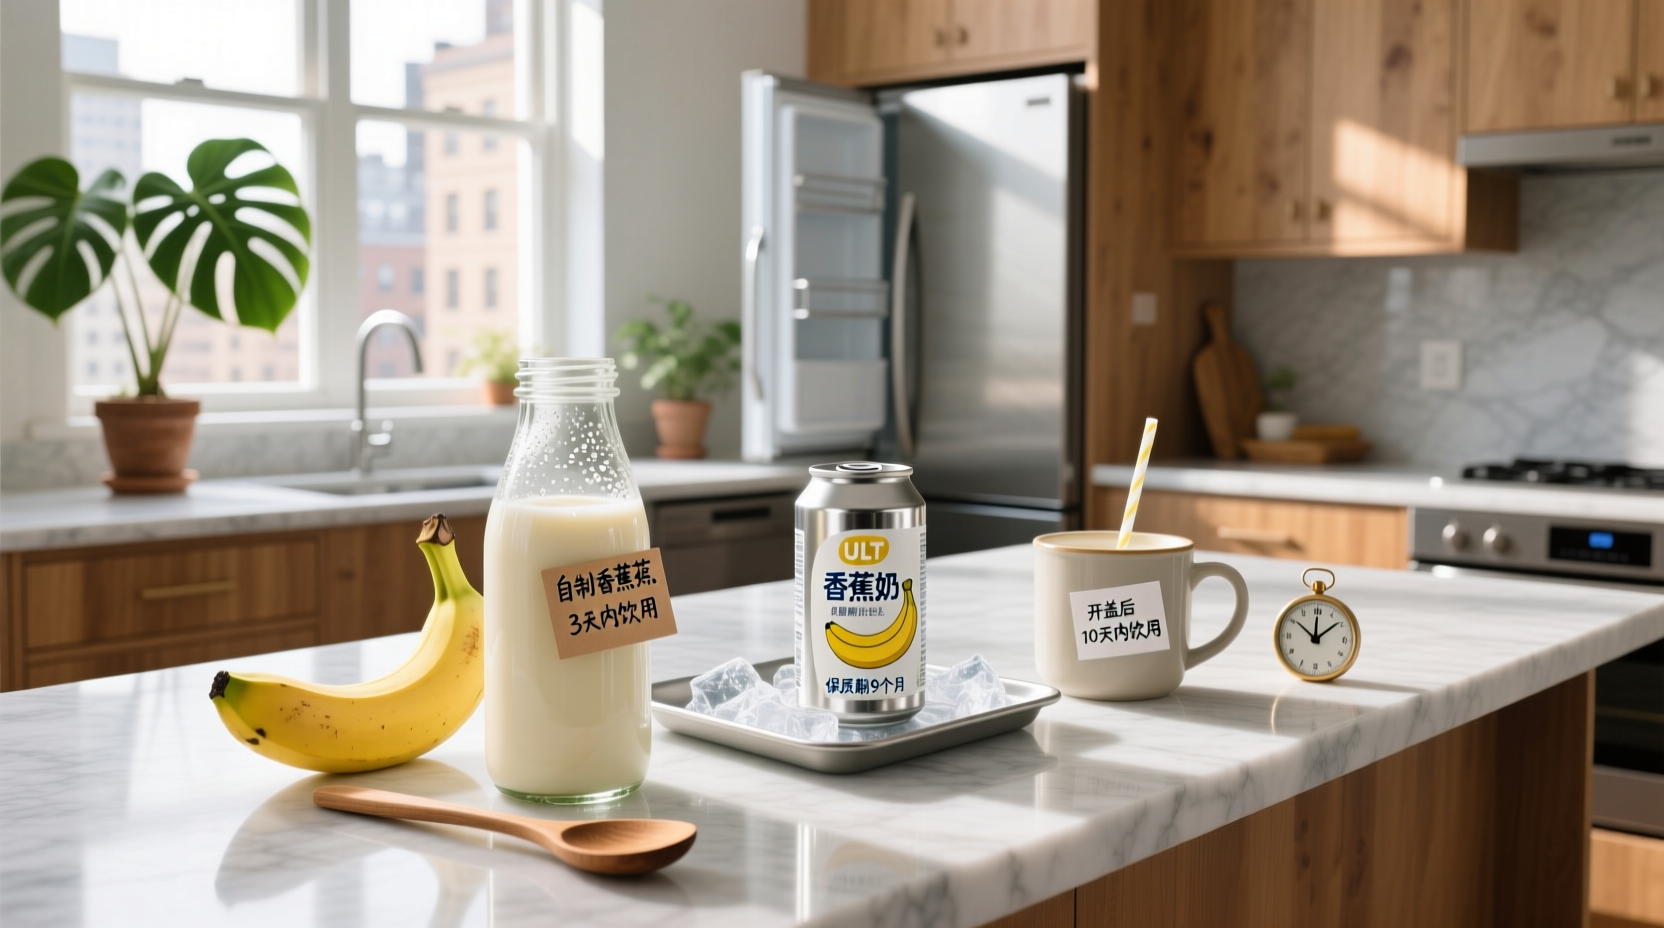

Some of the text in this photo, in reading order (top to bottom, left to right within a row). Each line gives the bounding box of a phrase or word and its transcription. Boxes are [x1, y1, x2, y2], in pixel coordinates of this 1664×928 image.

[844, 541, 885, 561] ULT
[823, 571, 899, 602] 香蕉奶
[568, 596, 658, 636] 3天内饮用
[1087, 598, 1135, 621] 开盖后
[1081, 619, 1161, 645] 10天内饮用
